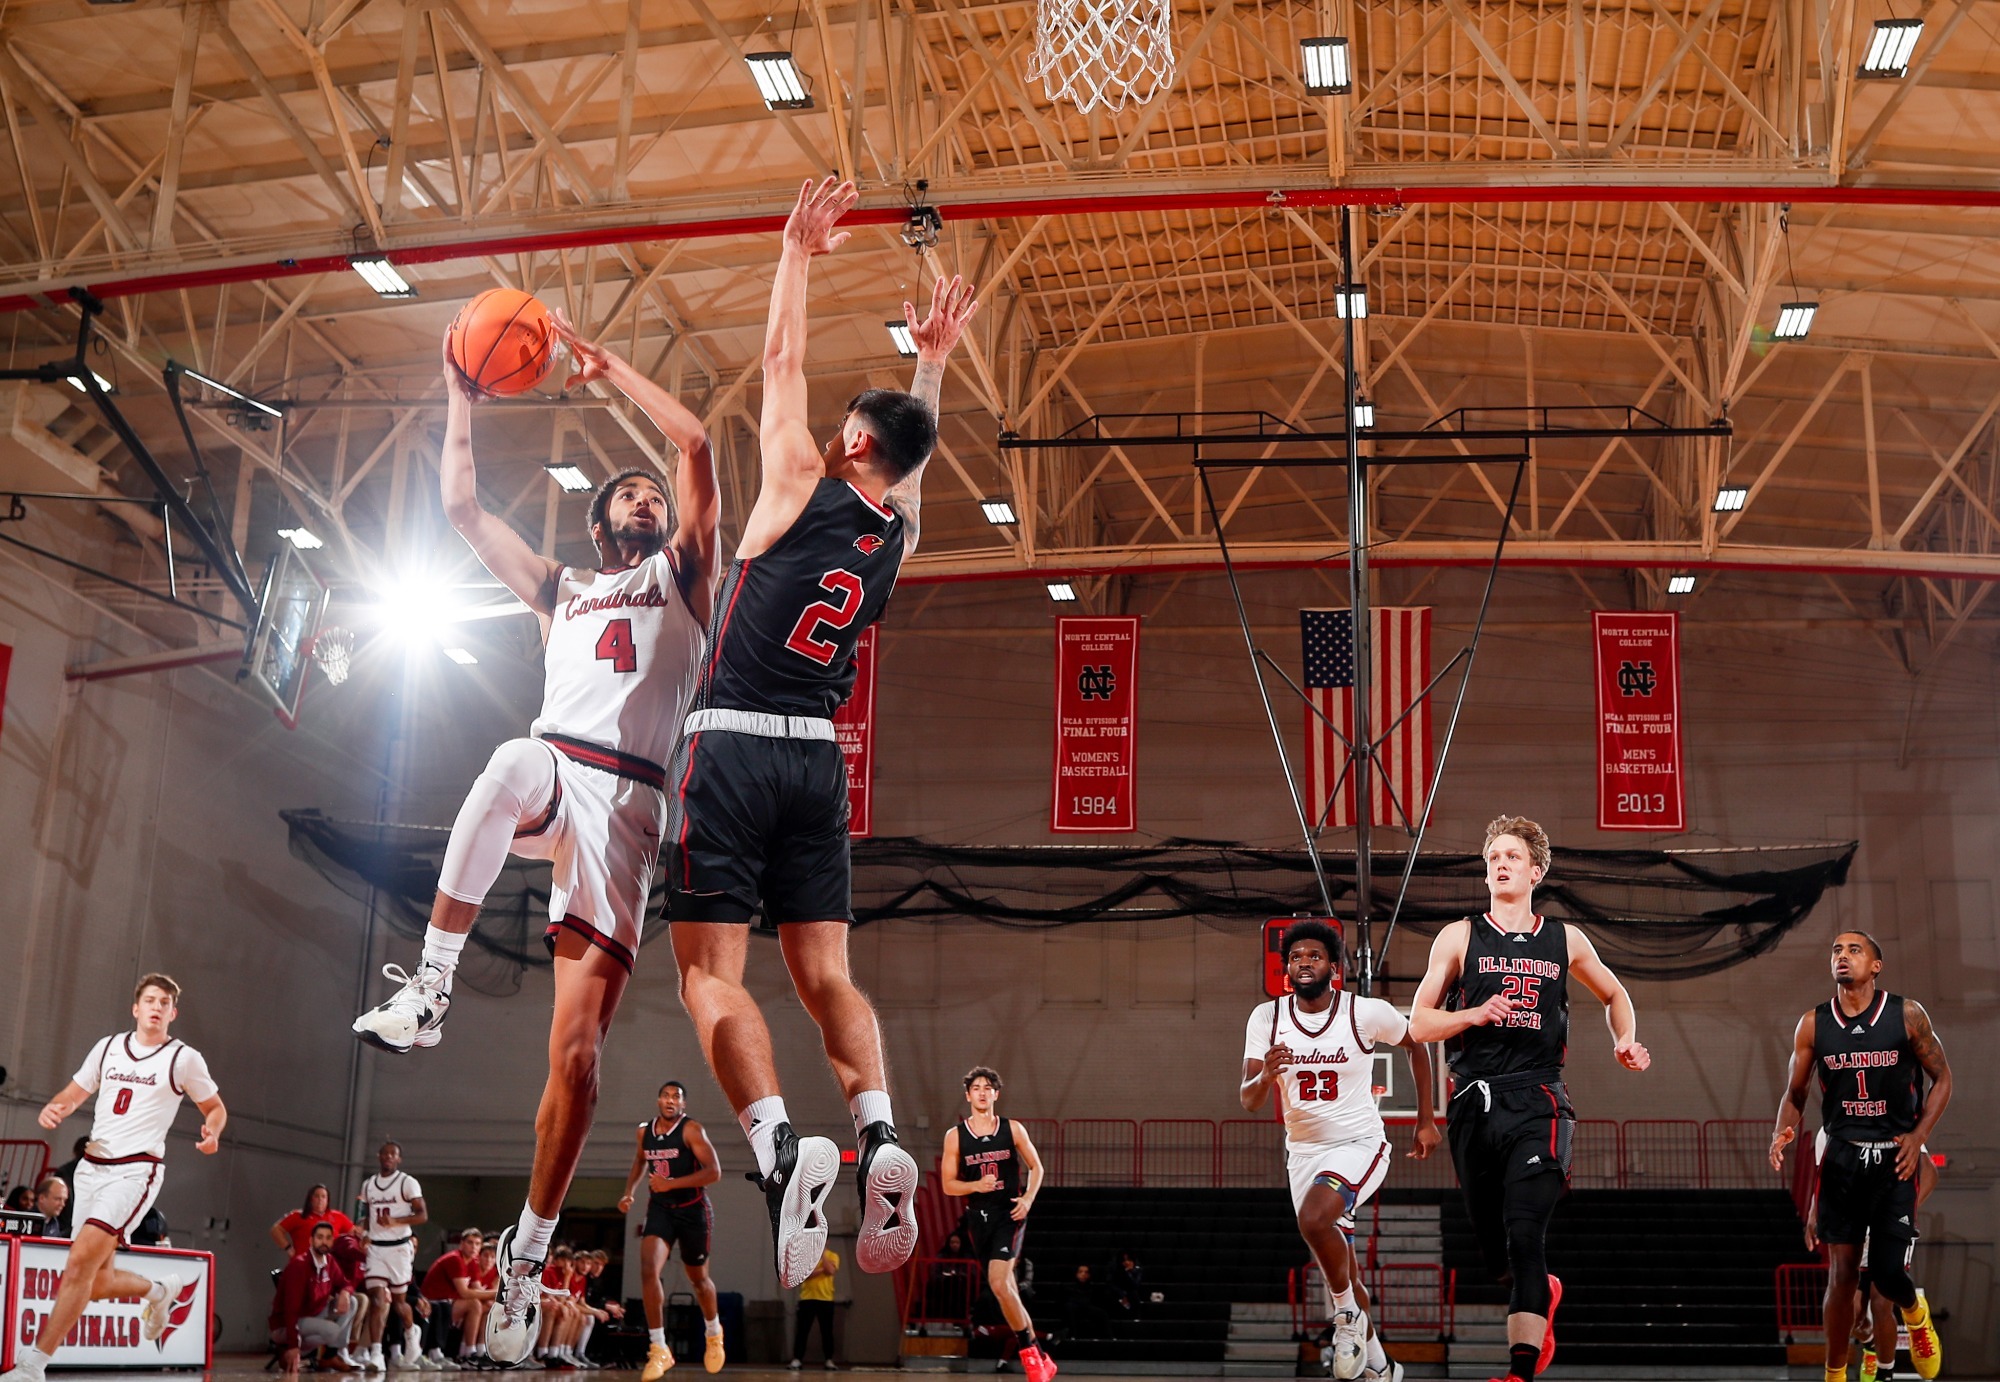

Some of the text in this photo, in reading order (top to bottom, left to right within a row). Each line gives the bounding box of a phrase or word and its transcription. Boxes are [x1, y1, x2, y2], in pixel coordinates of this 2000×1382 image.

[565, 584, 668, 621] Cardinals
[784, 568, 865, 666] 2
[1064, 633, 1131, 641] NORTH CENTRAL
[1602, 628, 1629, 636] NORTH
[595, 618, 637, 673] 4
[1619, 639, 1653, 647] COLLEGE
[1063, 717, 1082, 725] NCAA
[1086, 717, 1118, 725] DIVISION
[1604, 712, 1624, 721] NCAA
[1663, 713, 1672, 721] III
[1063, 726, 1128, 737] FINAL FOUR
[1605, 722, 1672, 734] FINAL FOUR
[1071, 752, 1119, 762] WOMEN'S
[1623, 749, 1656, 760] MEN'S
[1061, 765, 1128, 777] BASKETBALL
[1605, 763, 1674, 774] BASKETBALL
[1072, 796, 1117, 815] 1984
[1617, 793, 1665, 813] 2013
[1479, 956, 1560, 980] ILLINOIS
[1502, 975, 1541, 1009] 25
[1495, 1011, 1541, 1030] ECH
[1290, 1046, 1349, 1064] ardinals
[1824, 1050, 1899, 1070] ILLINOIS
[105, 1067, 157, 1086] Cardinals
[1296, 1070, 1338, 1101] 23
[1856, 1070, 1869, 1099] 1
[113, 1088, 133, 1115] 0
[1842, 1100, 1887, 1116] TECH
[23, 1267, 65, 1300] HOM
